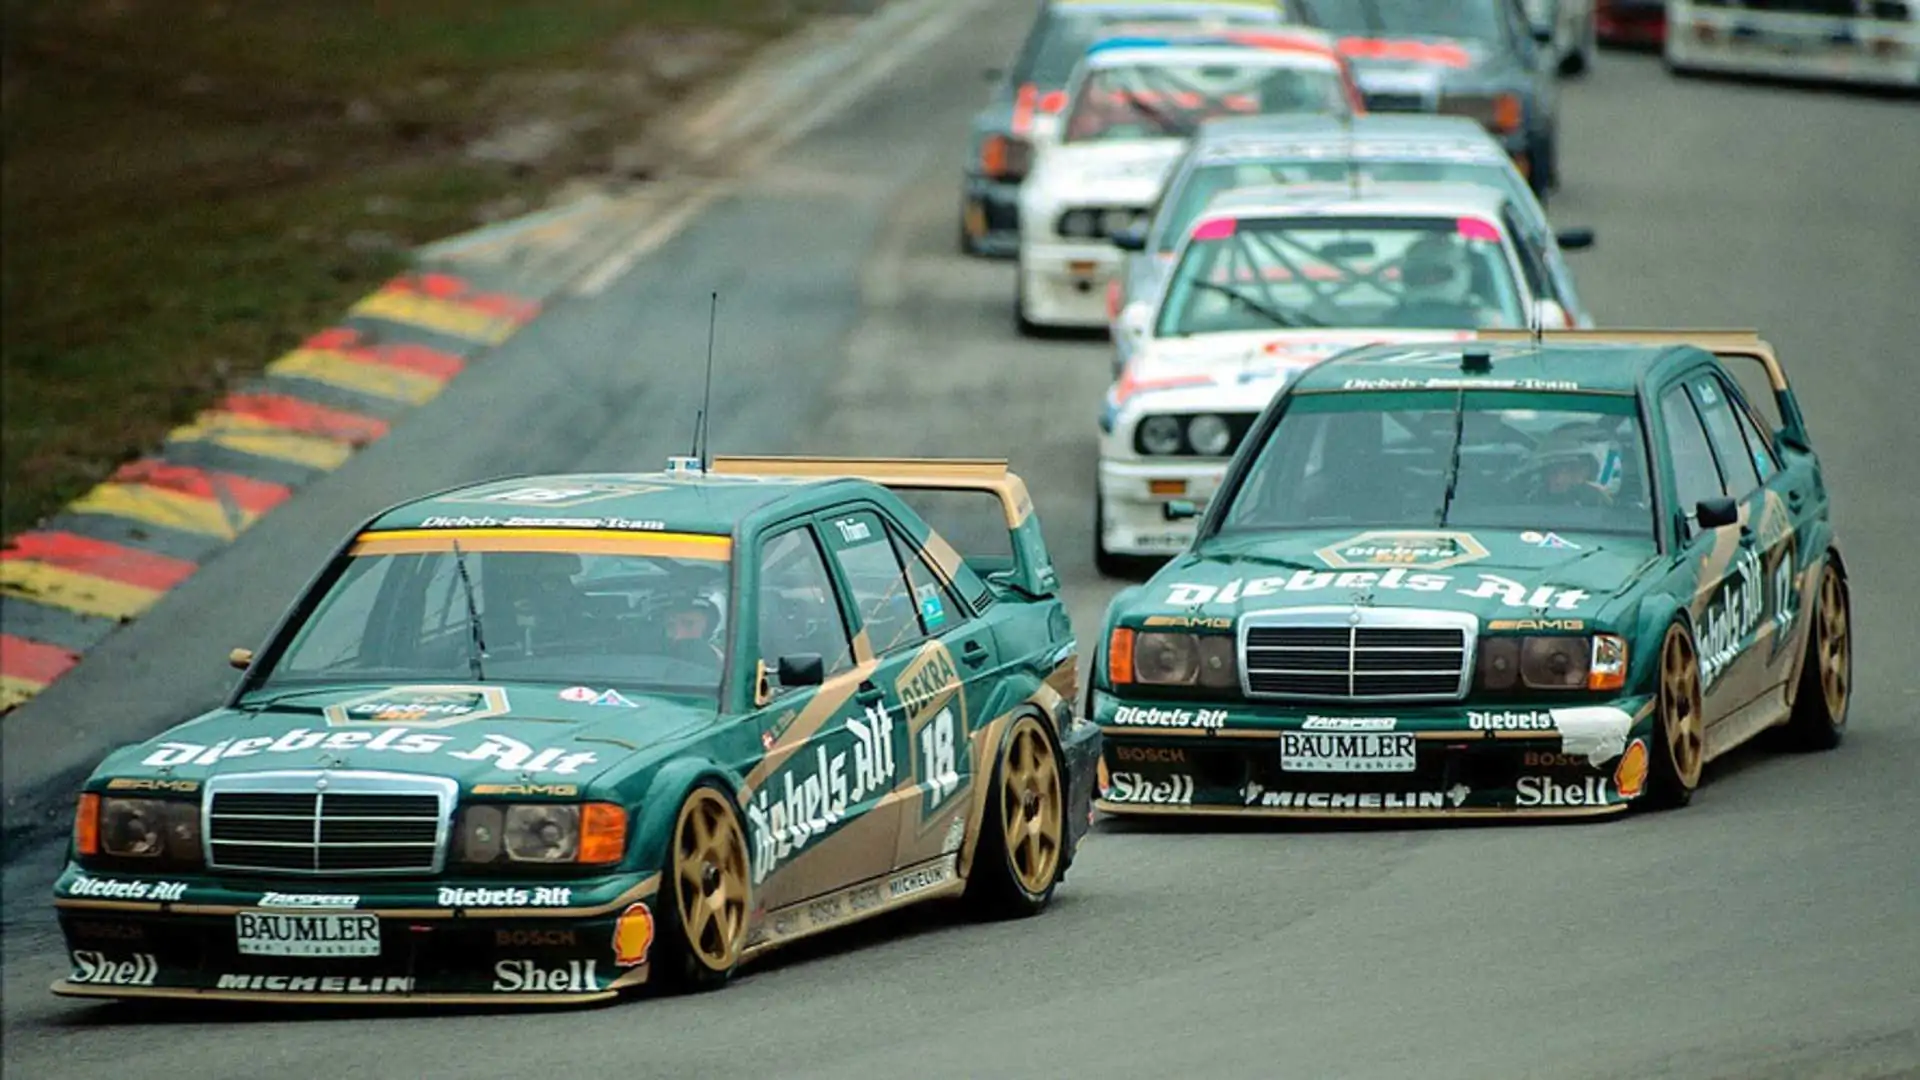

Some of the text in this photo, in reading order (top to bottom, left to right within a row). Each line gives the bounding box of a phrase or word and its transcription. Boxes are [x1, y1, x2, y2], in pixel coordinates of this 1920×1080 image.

[1164, 568, 1591, 609] Diebels Alt
[1169, 617, 1231, 628] AMG
[1515, 619, 1584, 631] AMG
[902, 652, 953, 718] DEKRA
[1115, 706, 1228, 728] Diebels Alt
[1467, 711, 1550, 729] Diebels
[142, 727, 597, 774] Diebels Alt
[920, 707, 958, 809] 18
[1117, 747, 1185, 762] BOSCH
[499, 785, 578, 797] AMG
[749, 700, 895, 884] Diebels Alt
[1108, 771, 1194, 804] Shell
[1261, 791, 1443, 807] MICHELIN
[1516, 775, 1608, 805] Shell
[69, 875, 189, 900] Diebels Alt
[889, 866, 944, 897] MICHELIN
[437, 886, 573, 906] Diebels Alt
[66, 951, 158, 985] Shell
[493, 959, 600, 992] Shell
[217, 974, 416, 992] MICHELIN
